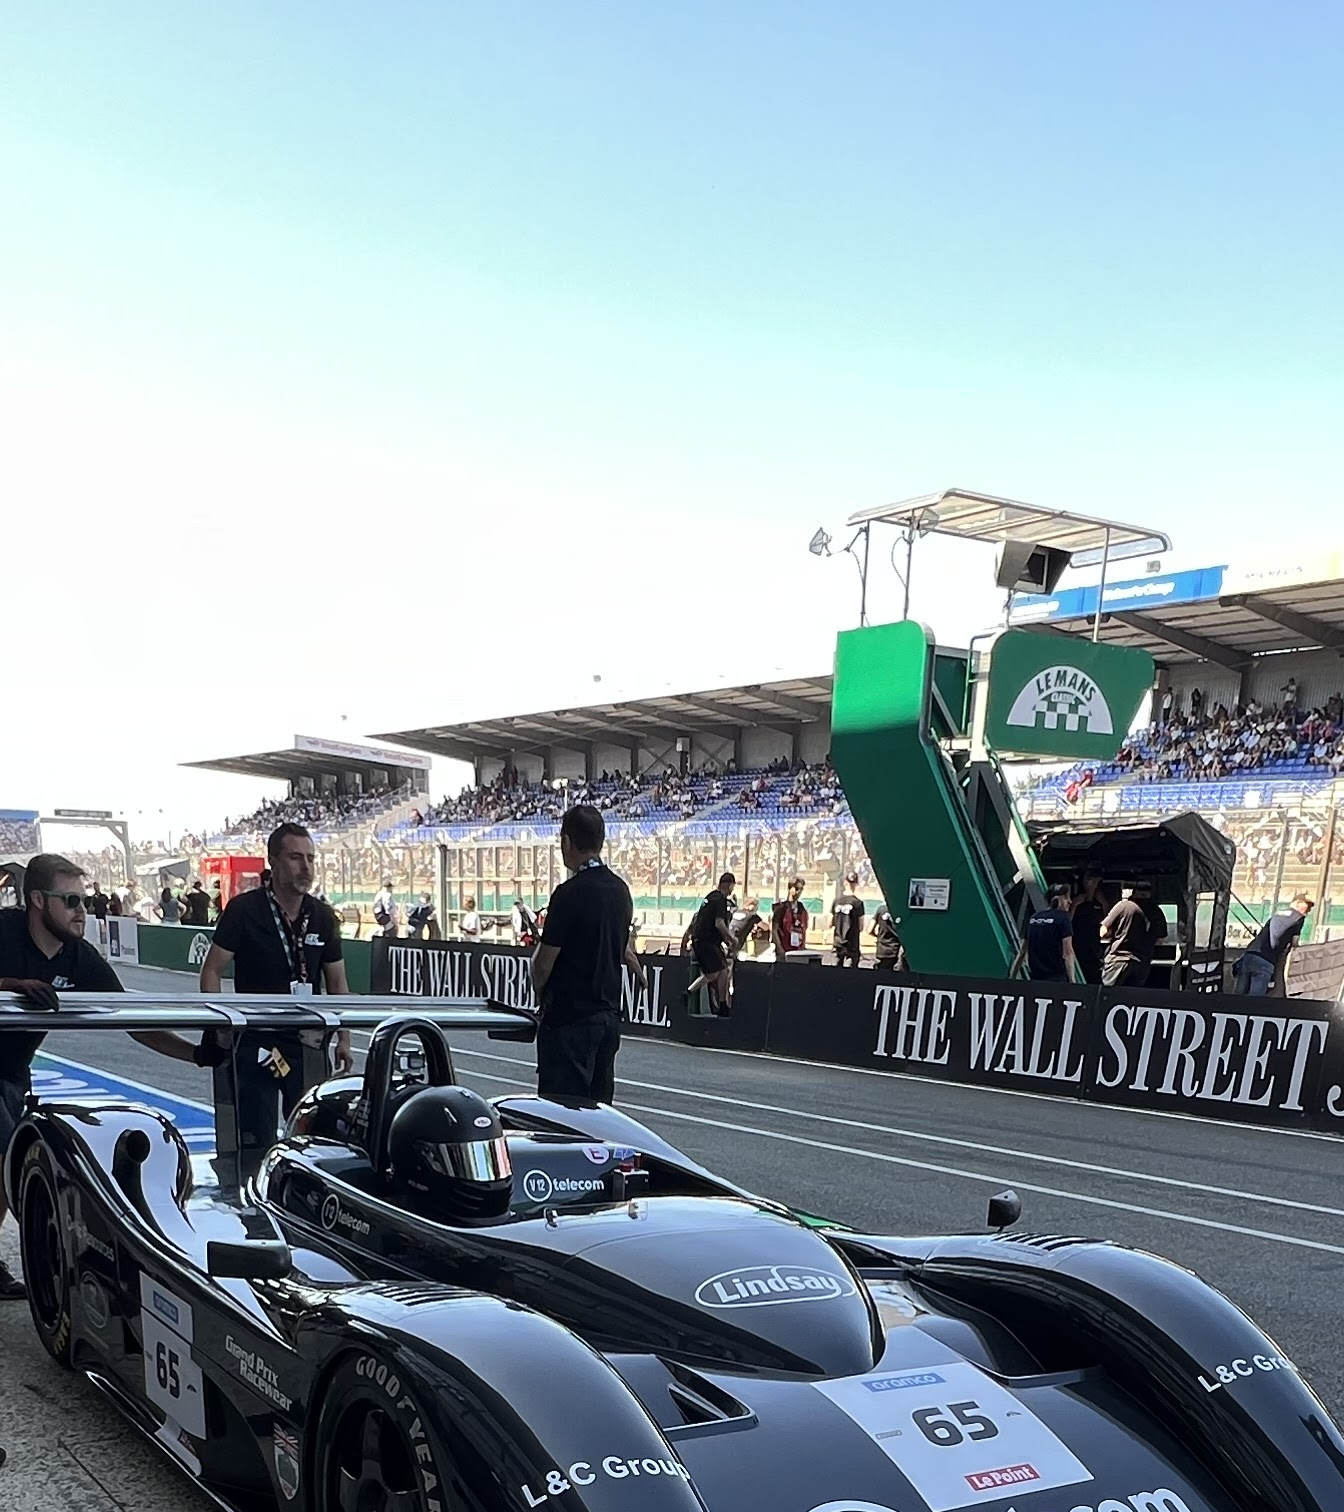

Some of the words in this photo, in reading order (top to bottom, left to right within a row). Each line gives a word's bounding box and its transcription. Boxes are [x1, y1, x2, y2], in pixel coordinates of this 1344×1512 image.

[1036, 672, 1052, 696] LE
[1054, 669, 1097, 702] MANS
[1226, 925, 1244, 940] Box
[388, 945, 424, 996] THE
[427, 950, 476, 999] WALL
[872, 984, 955, 1066] THE
[967, 993, 1086, 1085] WALL
[1095, 1003, 1332, 1112] STREET
[553, 1177, 605, 1192] telecom
[337, 1207, 371, 1236] telecom
[712, 1268, 842, 1304] Lindsay
[156, 1341, 181, 1399] 65
[225, 1334, 255, 1369] Grand
[256, 1355, 279, 1387] Prix
[1197, 1358, 1254, 1393] L&C
[239, 1359, 293, 1412] Racewear
[871, 1374, 938, 1391] aramco
[911, 1400, 1000, 1447] 65
[521, 1461, 597, 1509] L&C
[601, 1456, 691, 1483] Group
